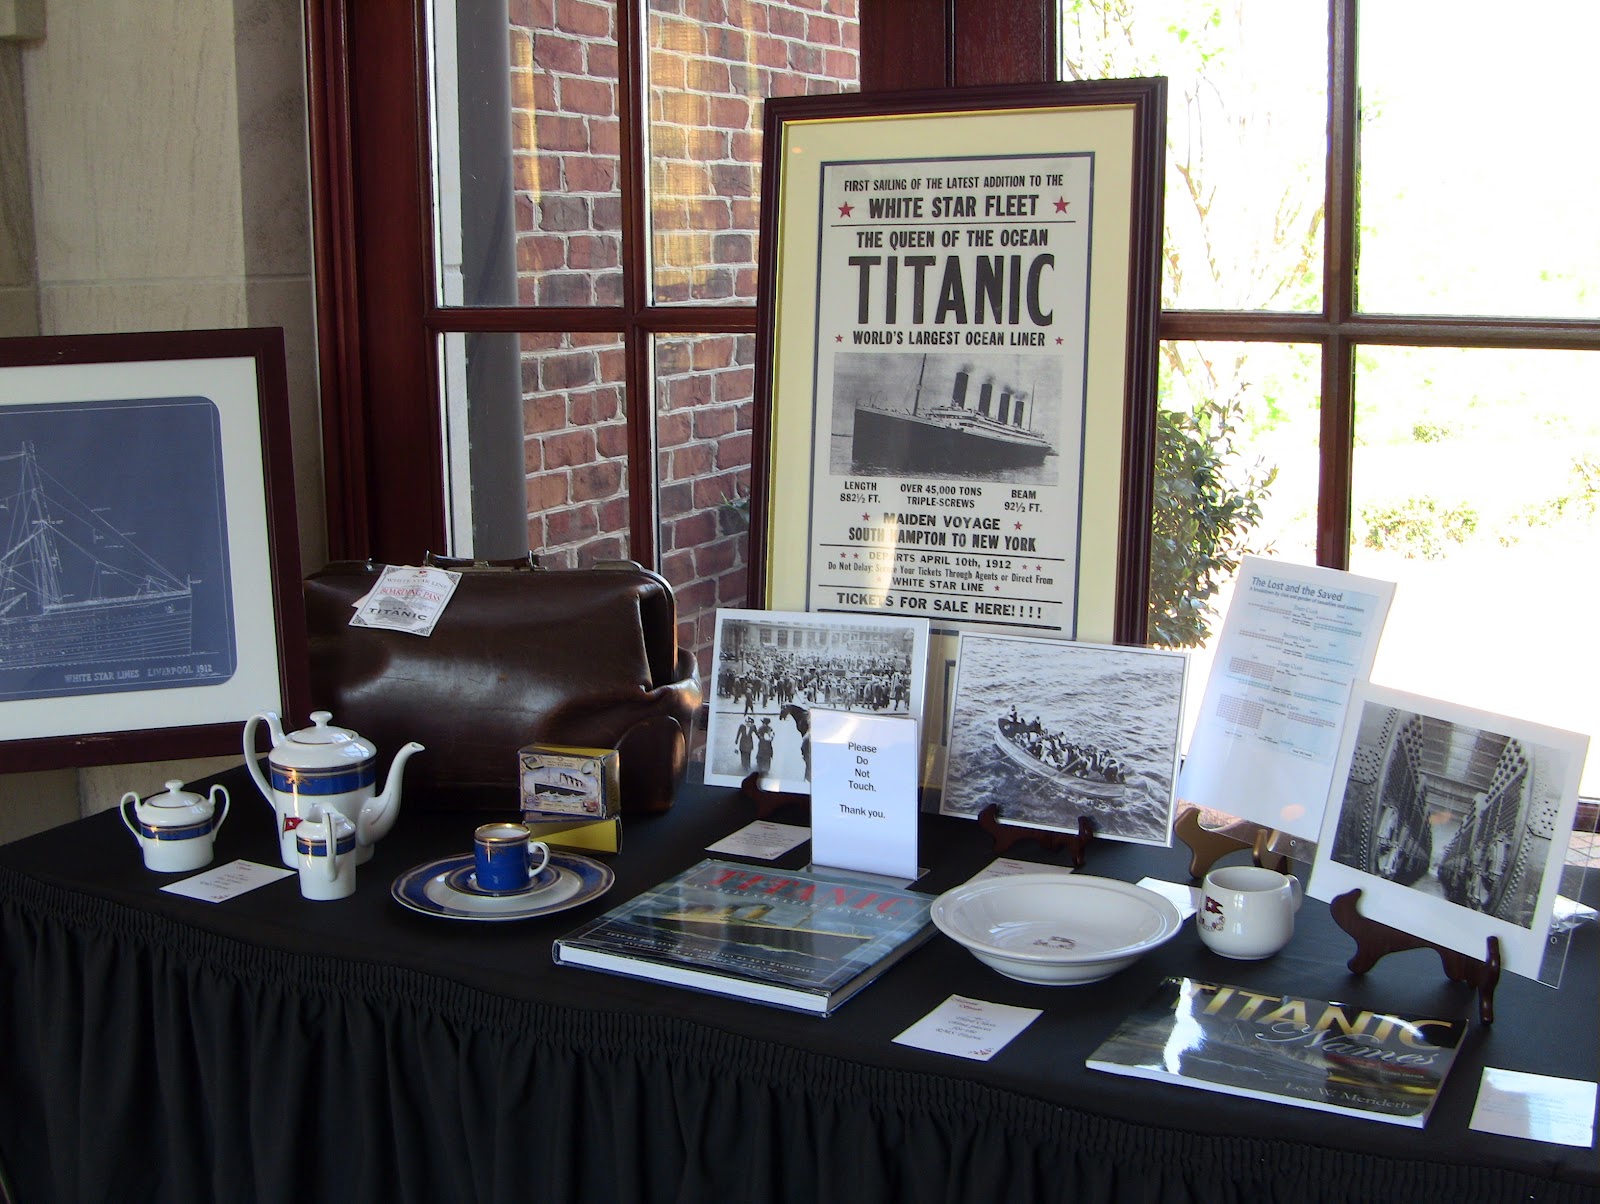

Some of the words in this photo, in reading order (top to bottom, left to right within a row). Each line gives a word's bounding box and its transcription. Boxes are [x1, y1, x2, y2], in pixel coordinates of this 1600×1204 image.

[844, 180, 870, 191] FIRST
[873, 179, 907, 190] SAILING
[911, 179, 921, 189] OF
[926, 178, 943, 189] THE
[947, 177, 979, 189] LATEST
[983, 176, 1025, 187] ADDITION
[1029, 175, 1041, 186] TO
[1046, 175, 1063, 186] THE
[869, 197, 923, 218] WHITE
[932, 196, 976, 217] STAR
[985, 195, 1039, 216] FLEET
[857, 232, 883, 248] THE
[889, 231, 934, 250] QUEEN
[941, 231, 960, 247] OF
[967, 230, 993, 246] THE
[1000, 229, 1048, 246] OCEAN
[848, 254, 1054, 326] TITANIC
[853, 330, 903, 345] WORLD'S
[909, 331, 960, 345] LARGEST
[966, 332, 1005, 345] OCEAN
[1010, 332, 1045, 346] LINER
[844, 482, 877, 491] LENGTH
[900, 484, 923, 493] OVER
[925, 485, 956, 496] 45,000
[959, 487, 982, 496] TONS
[868, 494, 881, 504] FT.
[1011, 490, 1036, 499] BEAM
[907, 496, 975, 509] TRIPLE-SCREWS
[1029, 503, 1042, 512] FT.
[883, 513, 936, 527] MAIDEN
[943, 516, 1000, 531] VOYAGE
[952, 533, 966, 547] TO
[972, 534, 998, 549] NEW
[1005, 536, 1036, 552] YORK
[920, 555, 950, 565] APRIL
[955, 557, 980, 569] 10th,
[985, 559, 1011, 569] 1912
[828, 561, 837, 570] Do
[839, 562, 851, 571] Not
[853, 562, 874, 574] Delay:
[900, 565, 915, 576] Your
[918, 567, 942, 577] Tickets
[945, 569, 972, 580] Through
[975, 570, 998, 582] Agents
[1001, 573, 1008, 582] or
[1011, 572, 1033, 583] Direct
[1035, 574, 1053, 585] From
[893, 577, 924, 587] WHITE
[929, 580, 956, 590] STAR
[961, 582, 984, 591] LINE
[1252, 577, 1265, 587] The
[1268, 581, 1284, 590] Lost
[1285, 585, 1300, 593] and
[1302, 586, 1315, 596] the
[1317, 589, 1343, 601] Saved
[837, 593, 894, 607] TICKETS
[900, 597, 927, 609] FOR
[933, 599, 969, 614] SALE
[369, 608, 427, 620] TITANIC
[65, 674, 92, 683] WHITE
[94, 672, 114, 681] STAR
[117, 670, 140, 679] LINES
[148, 666, 193, 677] LIVERPOOL
[197, 665, 212, 673] 1912
[848, 742, 877, 753] Please
[856, 755, 869, 765] Do
[855, 768, 870, 778] Not
[848, 780, 876, 792] Touch.
[839, 804, 866, 816] Thank
[868, 809, 886, 819] you.
[709, 869, 913, 915] TITANIC
[1255, 1021, 1441, 1065] Names
[1285, 1082, 1313, 1092] Lee
[1319, 1088, 1335, 1097] W.
[1341, 1092, 1411, 1109] Merideth
